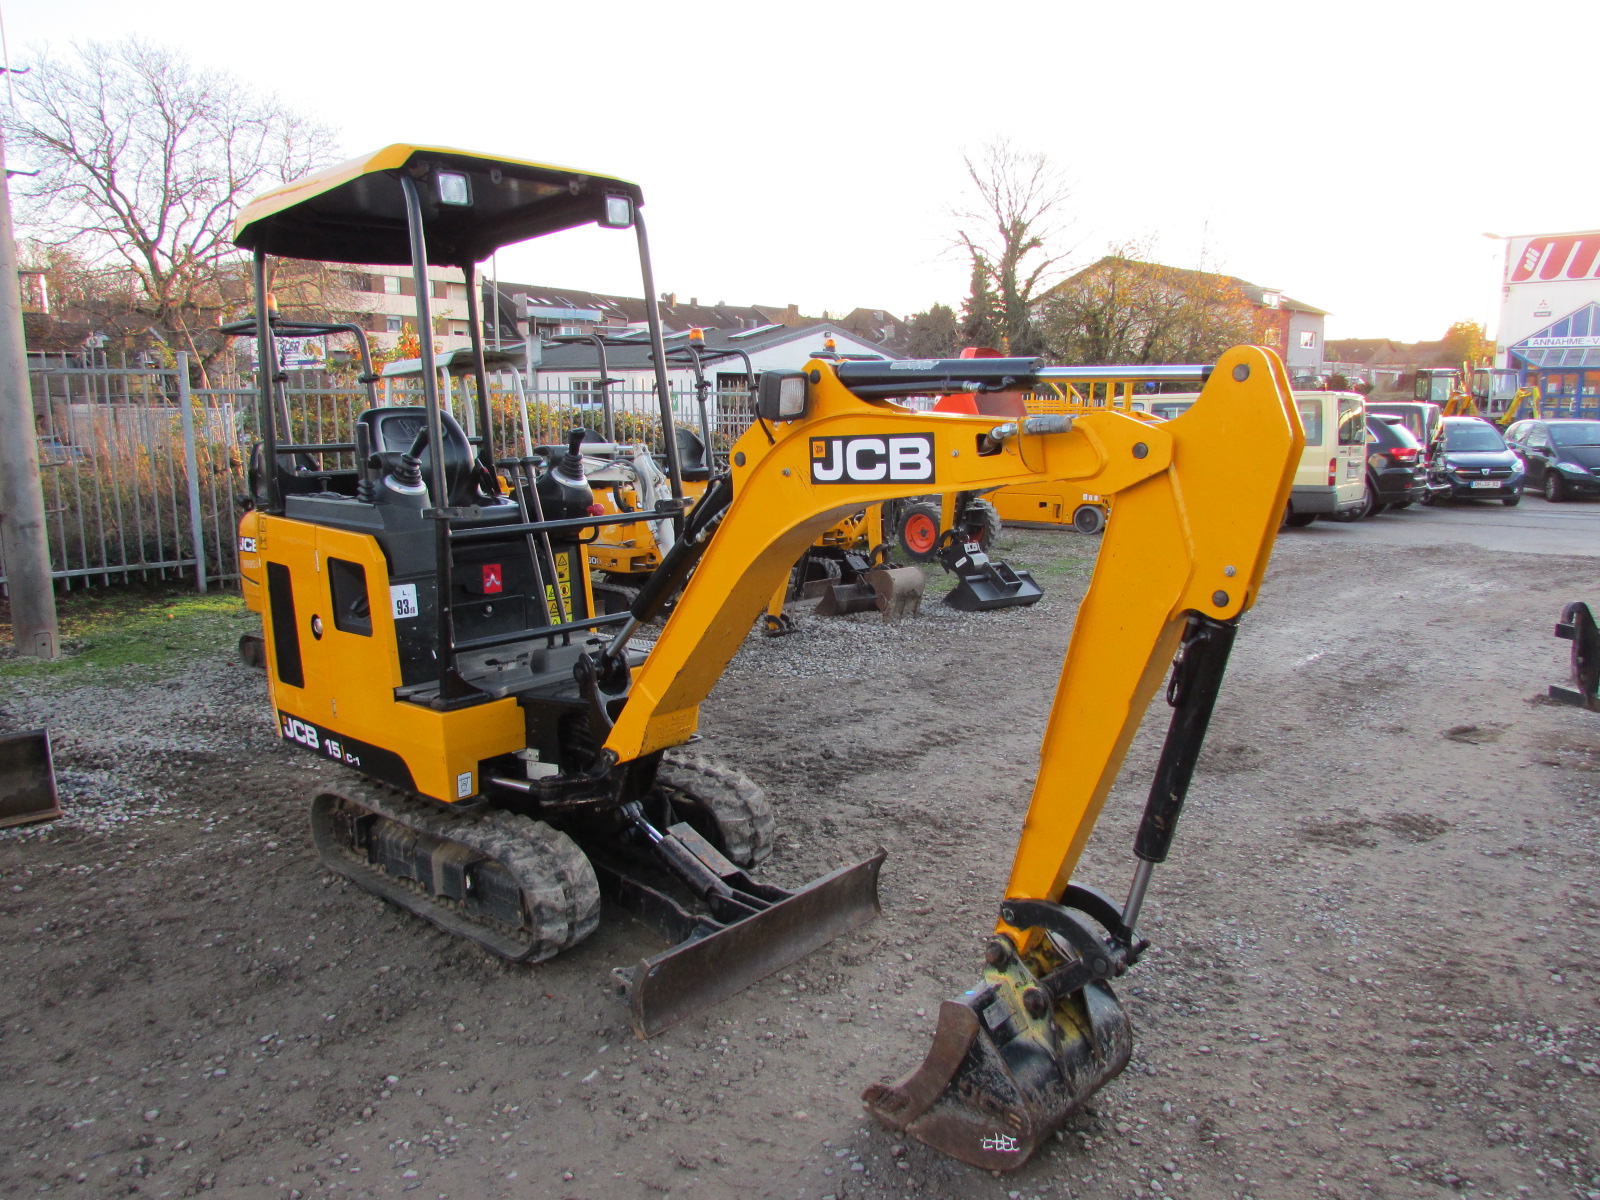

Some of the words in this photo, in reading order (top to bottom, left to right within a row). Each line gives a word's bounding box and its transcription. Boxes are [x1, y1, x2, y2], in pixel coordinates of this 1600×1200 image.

[813, 437, 933, 481] JCB
[396, 598, 410, 615] 93
[284, 717, 320, 749] JCB
